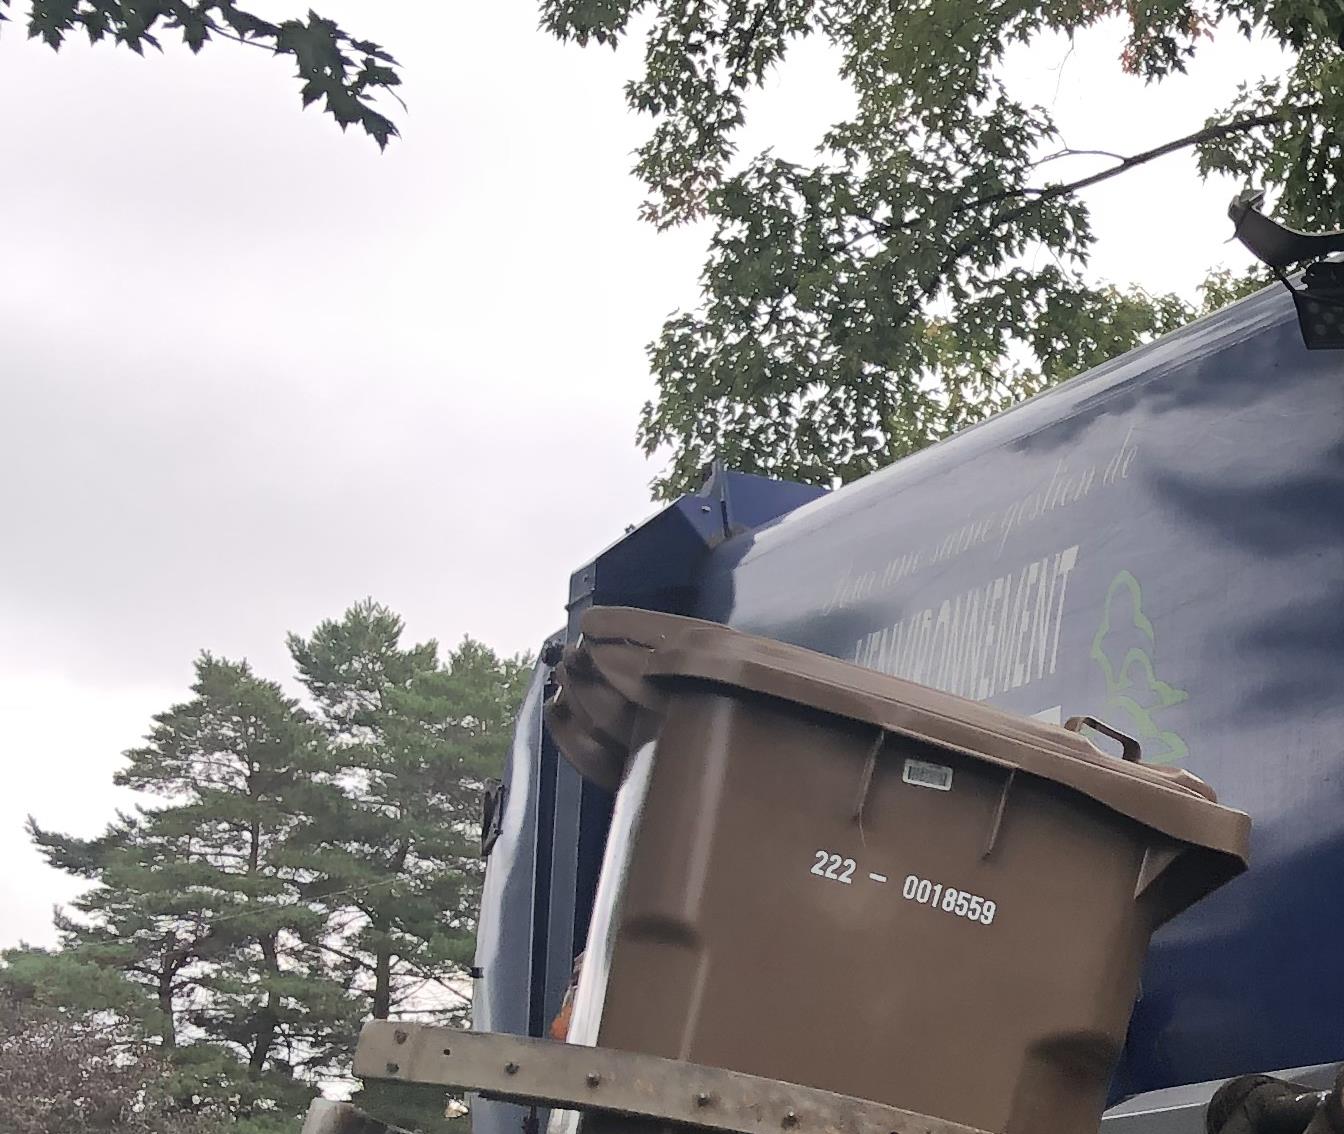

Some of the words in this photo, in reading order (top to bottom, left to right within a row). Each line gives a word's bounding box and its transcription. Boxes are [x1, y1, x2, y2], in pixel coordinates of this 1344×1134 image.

[994, 457, 1096, 559] gestion
[1103, 424, 1138, 486] de
[810, 850, 857, 884] 222
[903, 874, 996, 925] 0018559
